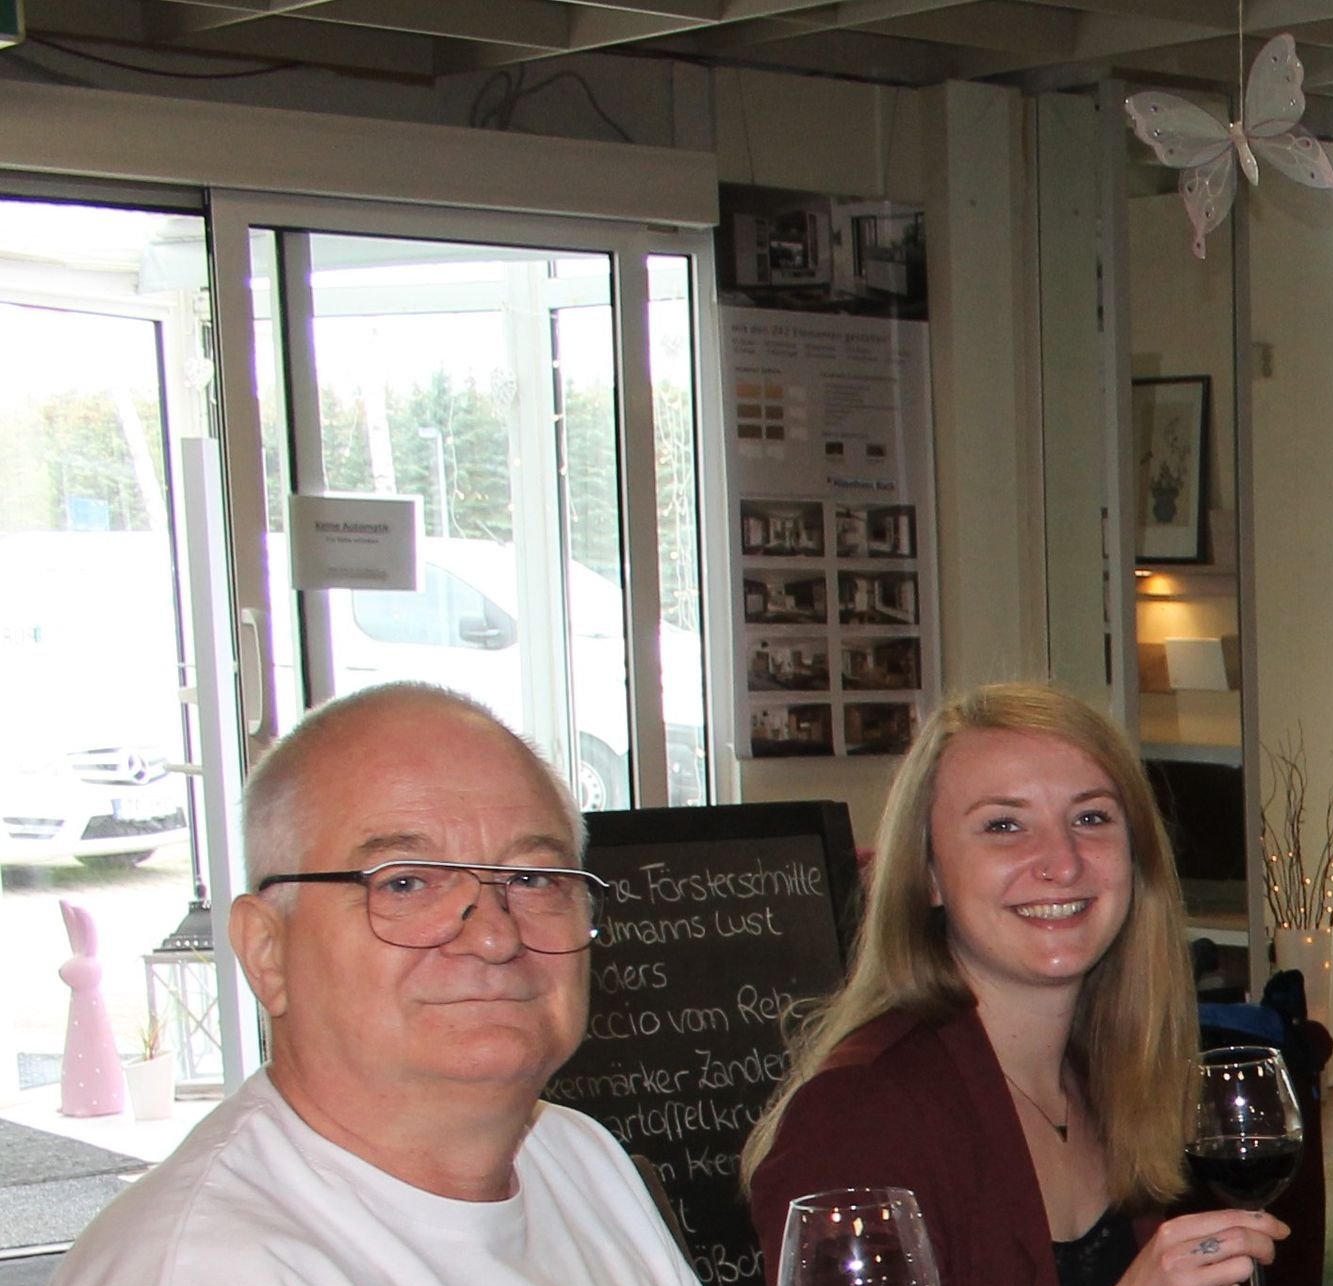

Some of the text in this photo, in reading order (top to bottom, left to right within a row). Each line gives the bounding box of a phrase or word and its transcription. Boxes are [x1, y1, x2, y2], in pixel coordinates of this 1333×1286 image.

[639, 857, 824, 905] Försterschnitte
[596, 906, 783, 947] dmanns Lust
[587, 1000, 661, 1040] ccio
[667, 1007, 729, 1034] vom
[545, 1047, 790, 1100] kermärker Zander
